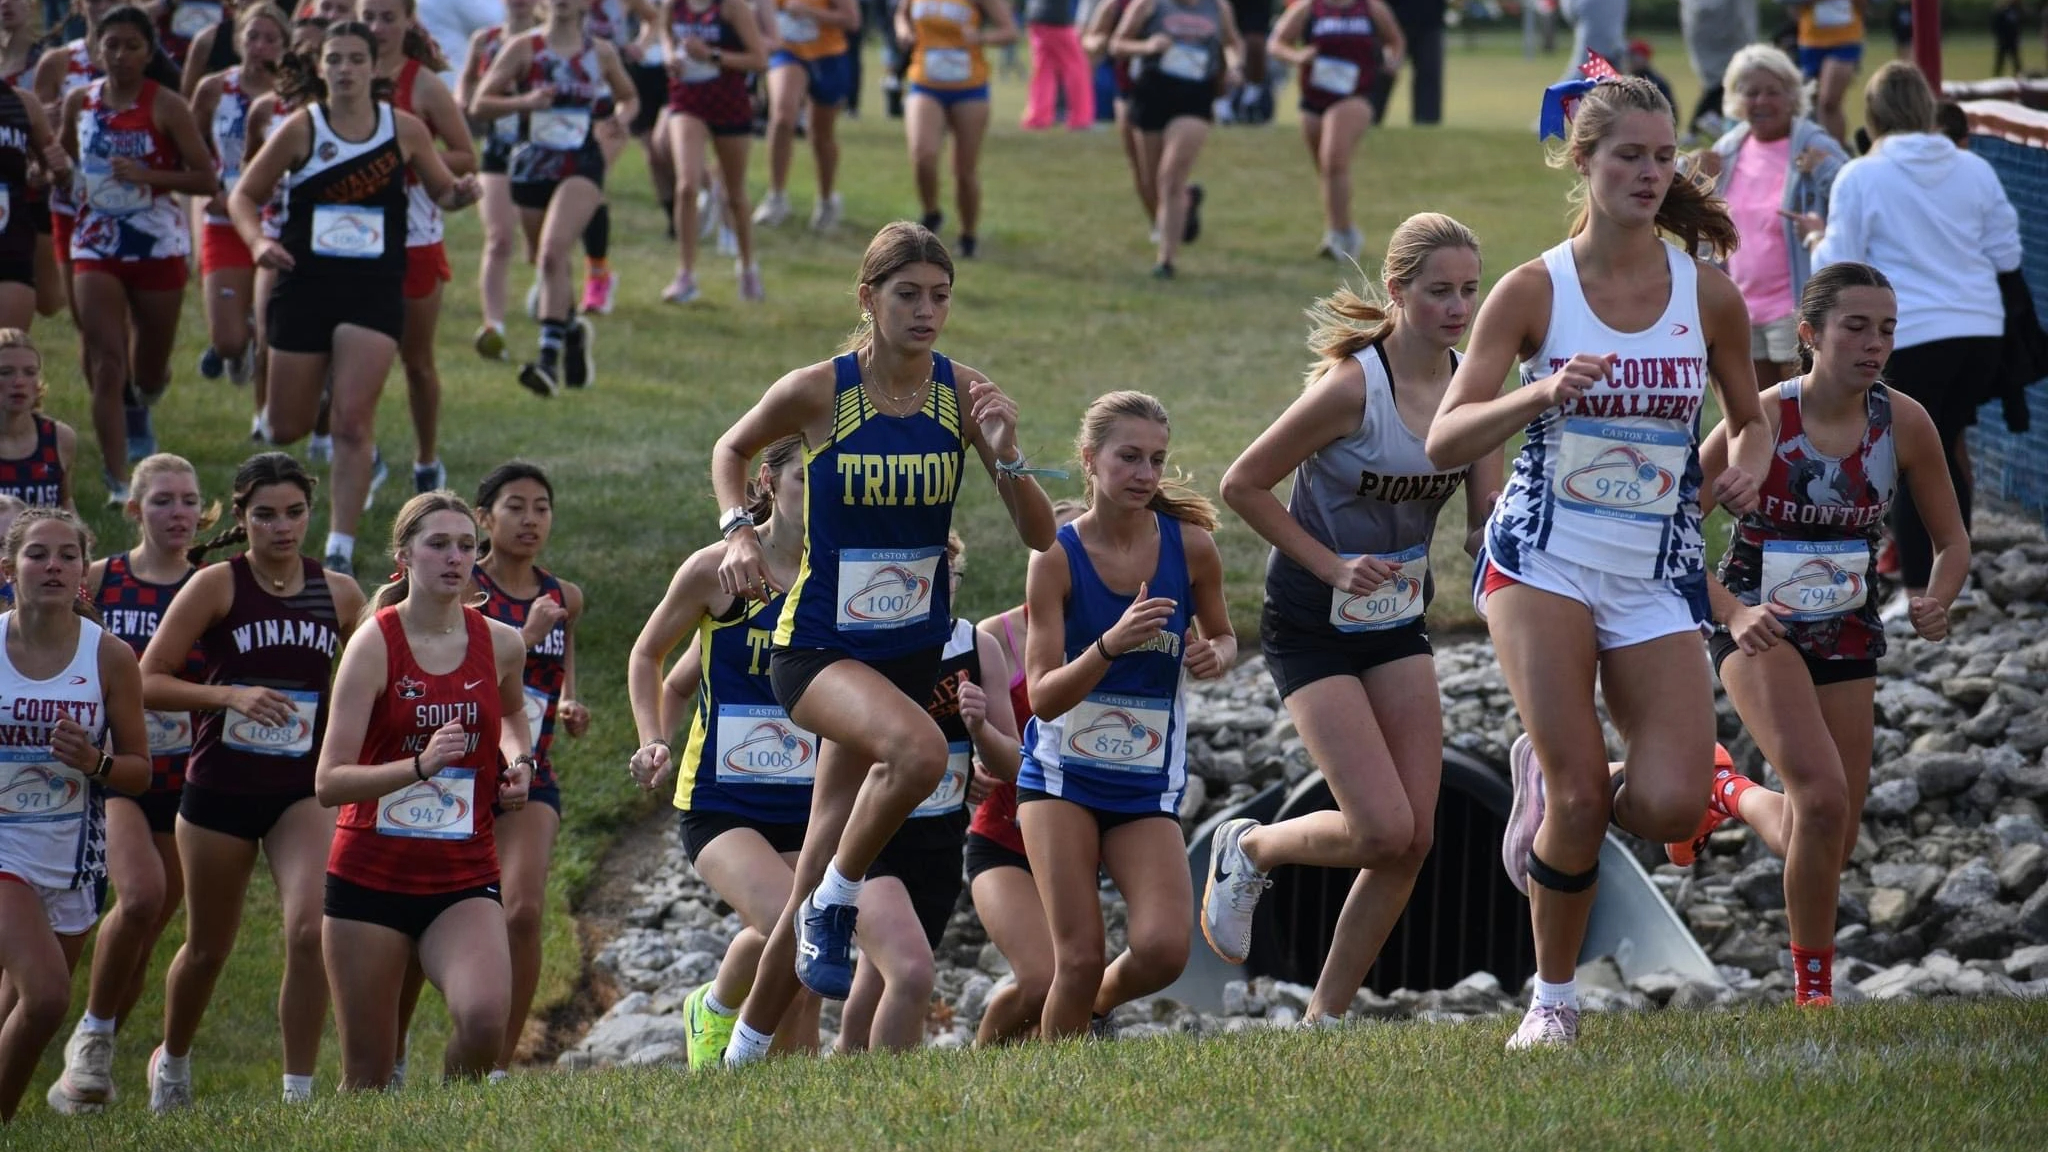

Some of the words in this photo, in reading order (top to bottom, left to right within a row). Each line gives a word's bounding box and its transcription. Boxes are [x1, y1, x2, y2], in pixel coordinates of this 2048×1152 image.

[1601, 428, 1641, 441] CASTON
[1643, 432, 1660, 442] XC
[837, 451, 959, 506] TRITON
[1595, 477, 1641, 501] 978
[1765, 495, 1889, 526] FRONTIER
[871, 552, 907, 561] CASTON
[909, 551, 922, 560] XC
[1796, 543, 1832, 553] CASTON
[868, 593, 912, 613] 1007
[1366, 596, 1397, 618] 901
[1800, 587, 1838, 607] 794
[231, 619, 337, 659] WINAMAC
[416, 702, 477, 728] SOUTH
[749, 707, 783, 717] CASTON
[1094, 734, 1134, 756] 875
[747, 750, 793, 768] 1008
[16, 792, 50, 810] 971
[410, 807, 444, 823] 947
